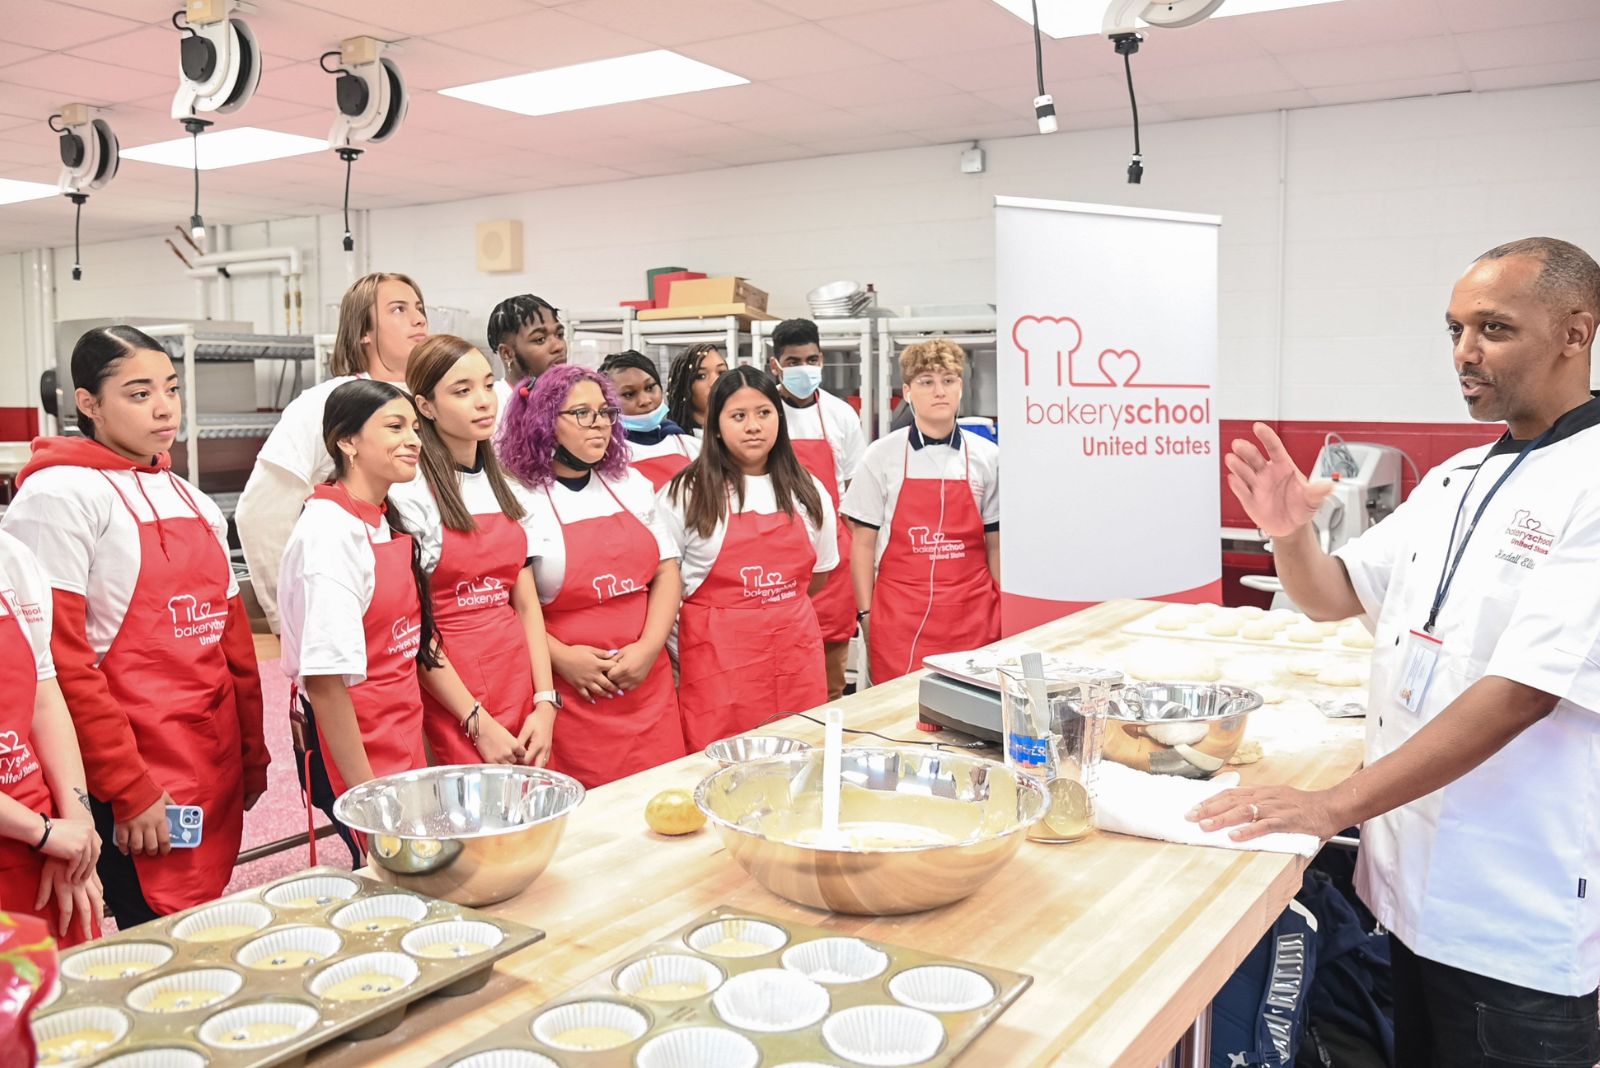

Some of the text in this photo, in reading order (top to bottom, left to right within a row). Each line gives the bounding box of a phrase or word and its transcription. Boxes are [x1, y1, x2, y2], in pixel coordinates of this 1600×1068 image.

[1026, 396, 1210, 431] bakeryschool
[1082, 436, 1211, 456] United States
